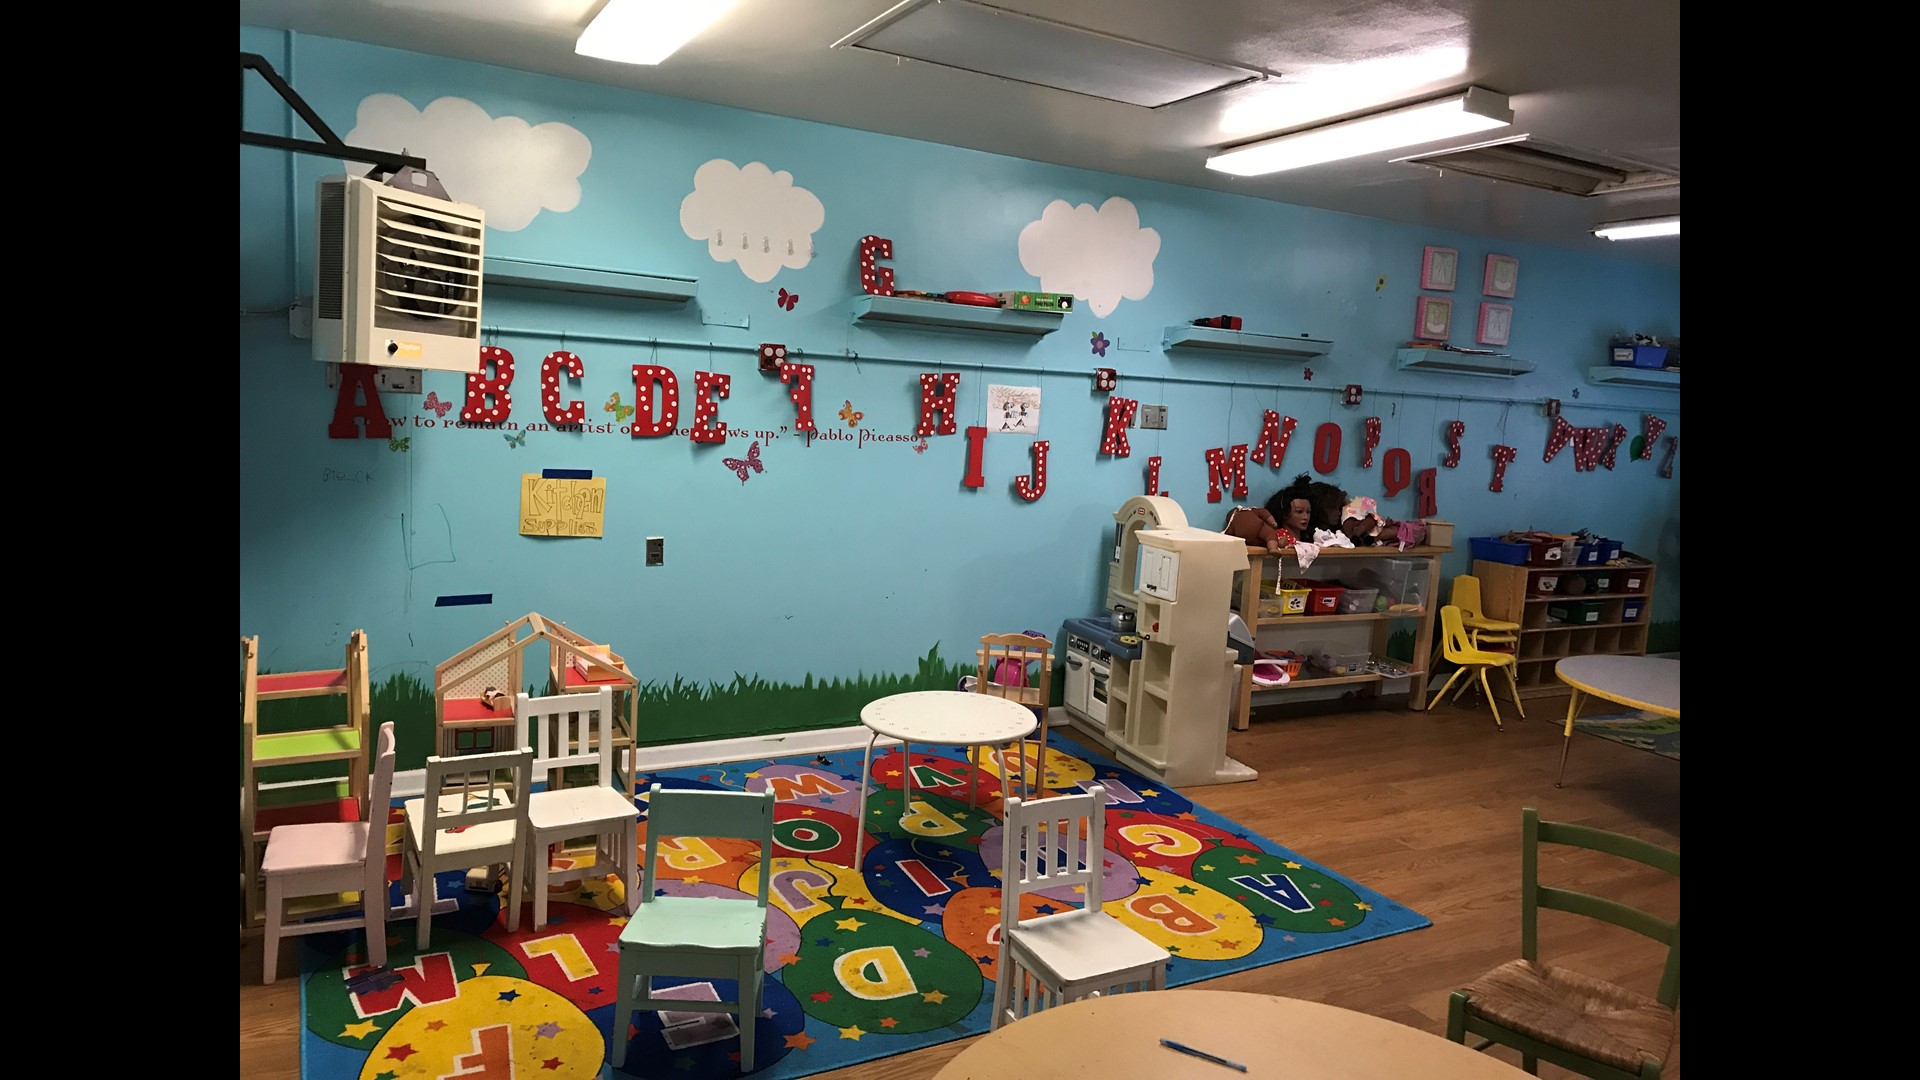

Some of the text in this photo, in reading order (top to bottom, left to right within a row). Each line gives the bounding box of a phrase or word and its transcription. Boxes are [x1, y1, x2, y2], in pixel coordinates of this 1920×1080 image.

[860, 235, 894, 296] G
[329, 346, 731, 443] A B C D E
[414, 414, 435, 428] to
[525, 421, 550, 432] an
[556, 418, 616, 433] artist
[806, 427, 854, 447] Pablo
[858, 428, 919, 448] Picasso
[916, 373, 1381, 503] H I J K L M N O P
[1445, 420, 1465, 467] S
[1489, 445, 1517, 492] T
[527, 478, 604, 521] Kitchen
[833, 945, 919, 1000] D
[1125, 894, 1220, 937] B
[1227, 873, 1316, 913] A
